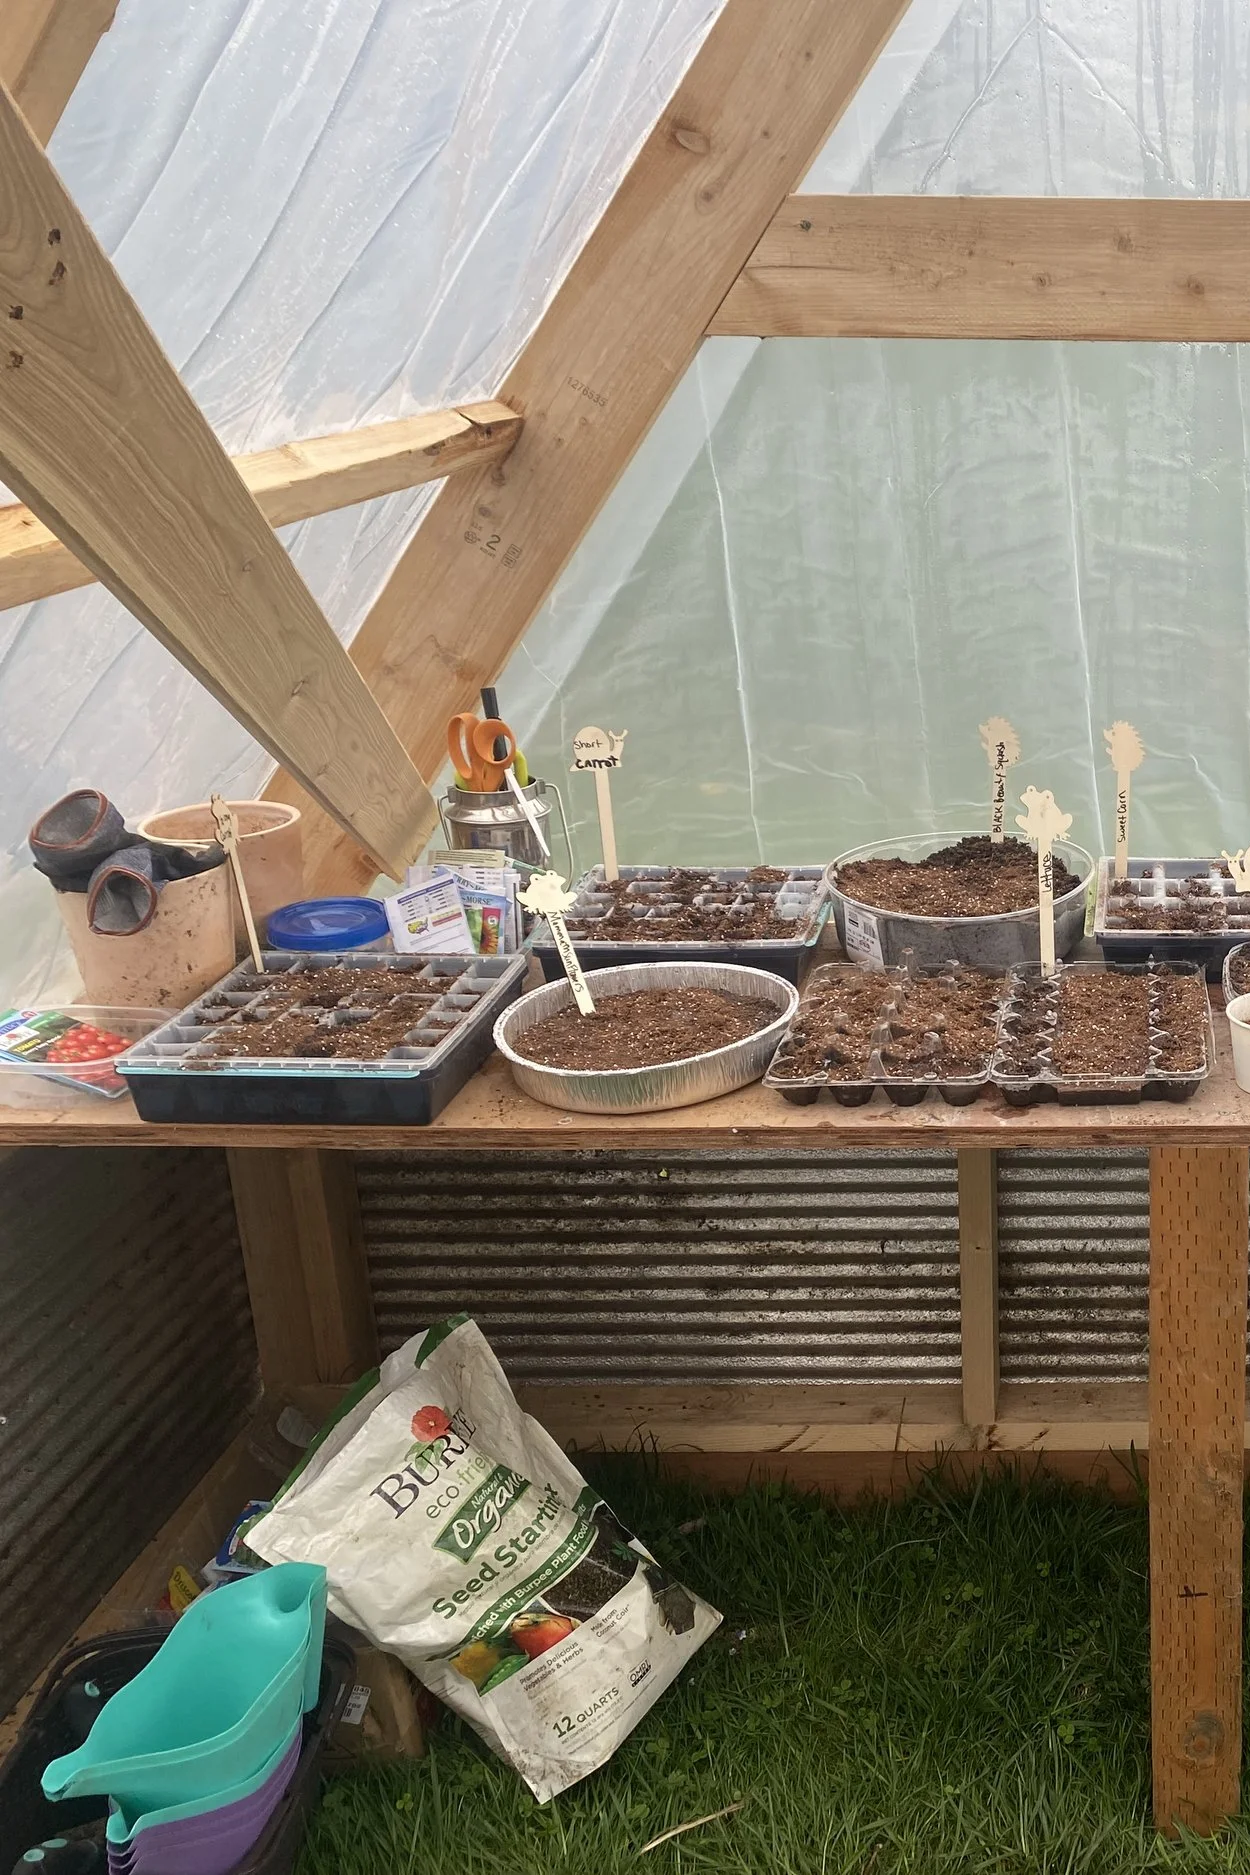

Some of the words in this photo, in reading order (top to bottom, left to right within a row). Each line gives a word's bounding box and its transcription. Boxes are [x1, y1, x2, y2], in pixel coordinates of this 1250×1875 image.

[486, 534, 501, 551] 2
[574, 739, 603, 750] Short
[1117, 790, 1127, 814] Corn
[1117, 816, 1127, 843] Sweet
[1040, 851, 1054, 893] Lettuce
[432, 1562, 500, 1620] Seed
[494, 1496, 561, 1569] Startin
[472, 1611, 500, 1641] iched
[514, 1568, 553, 1599] Burpee
[551, 1543, 577, 1569] Plant
[573, 1521, 589, 1544] Food
[595, 1619, 617, 1638] Coconut
[602, 1608, 618, 1625] from
[520, 1663, 547, 1684] Promotes
[546, 1642, 579, 1667] Delicious
[523, 1667, 556, 1692] Vegetables
[562, 1647, 584, 1664] Herbs
[552, 1715, 576, 1738] 12
[576, 1686, 620, 1723] QUARTS
